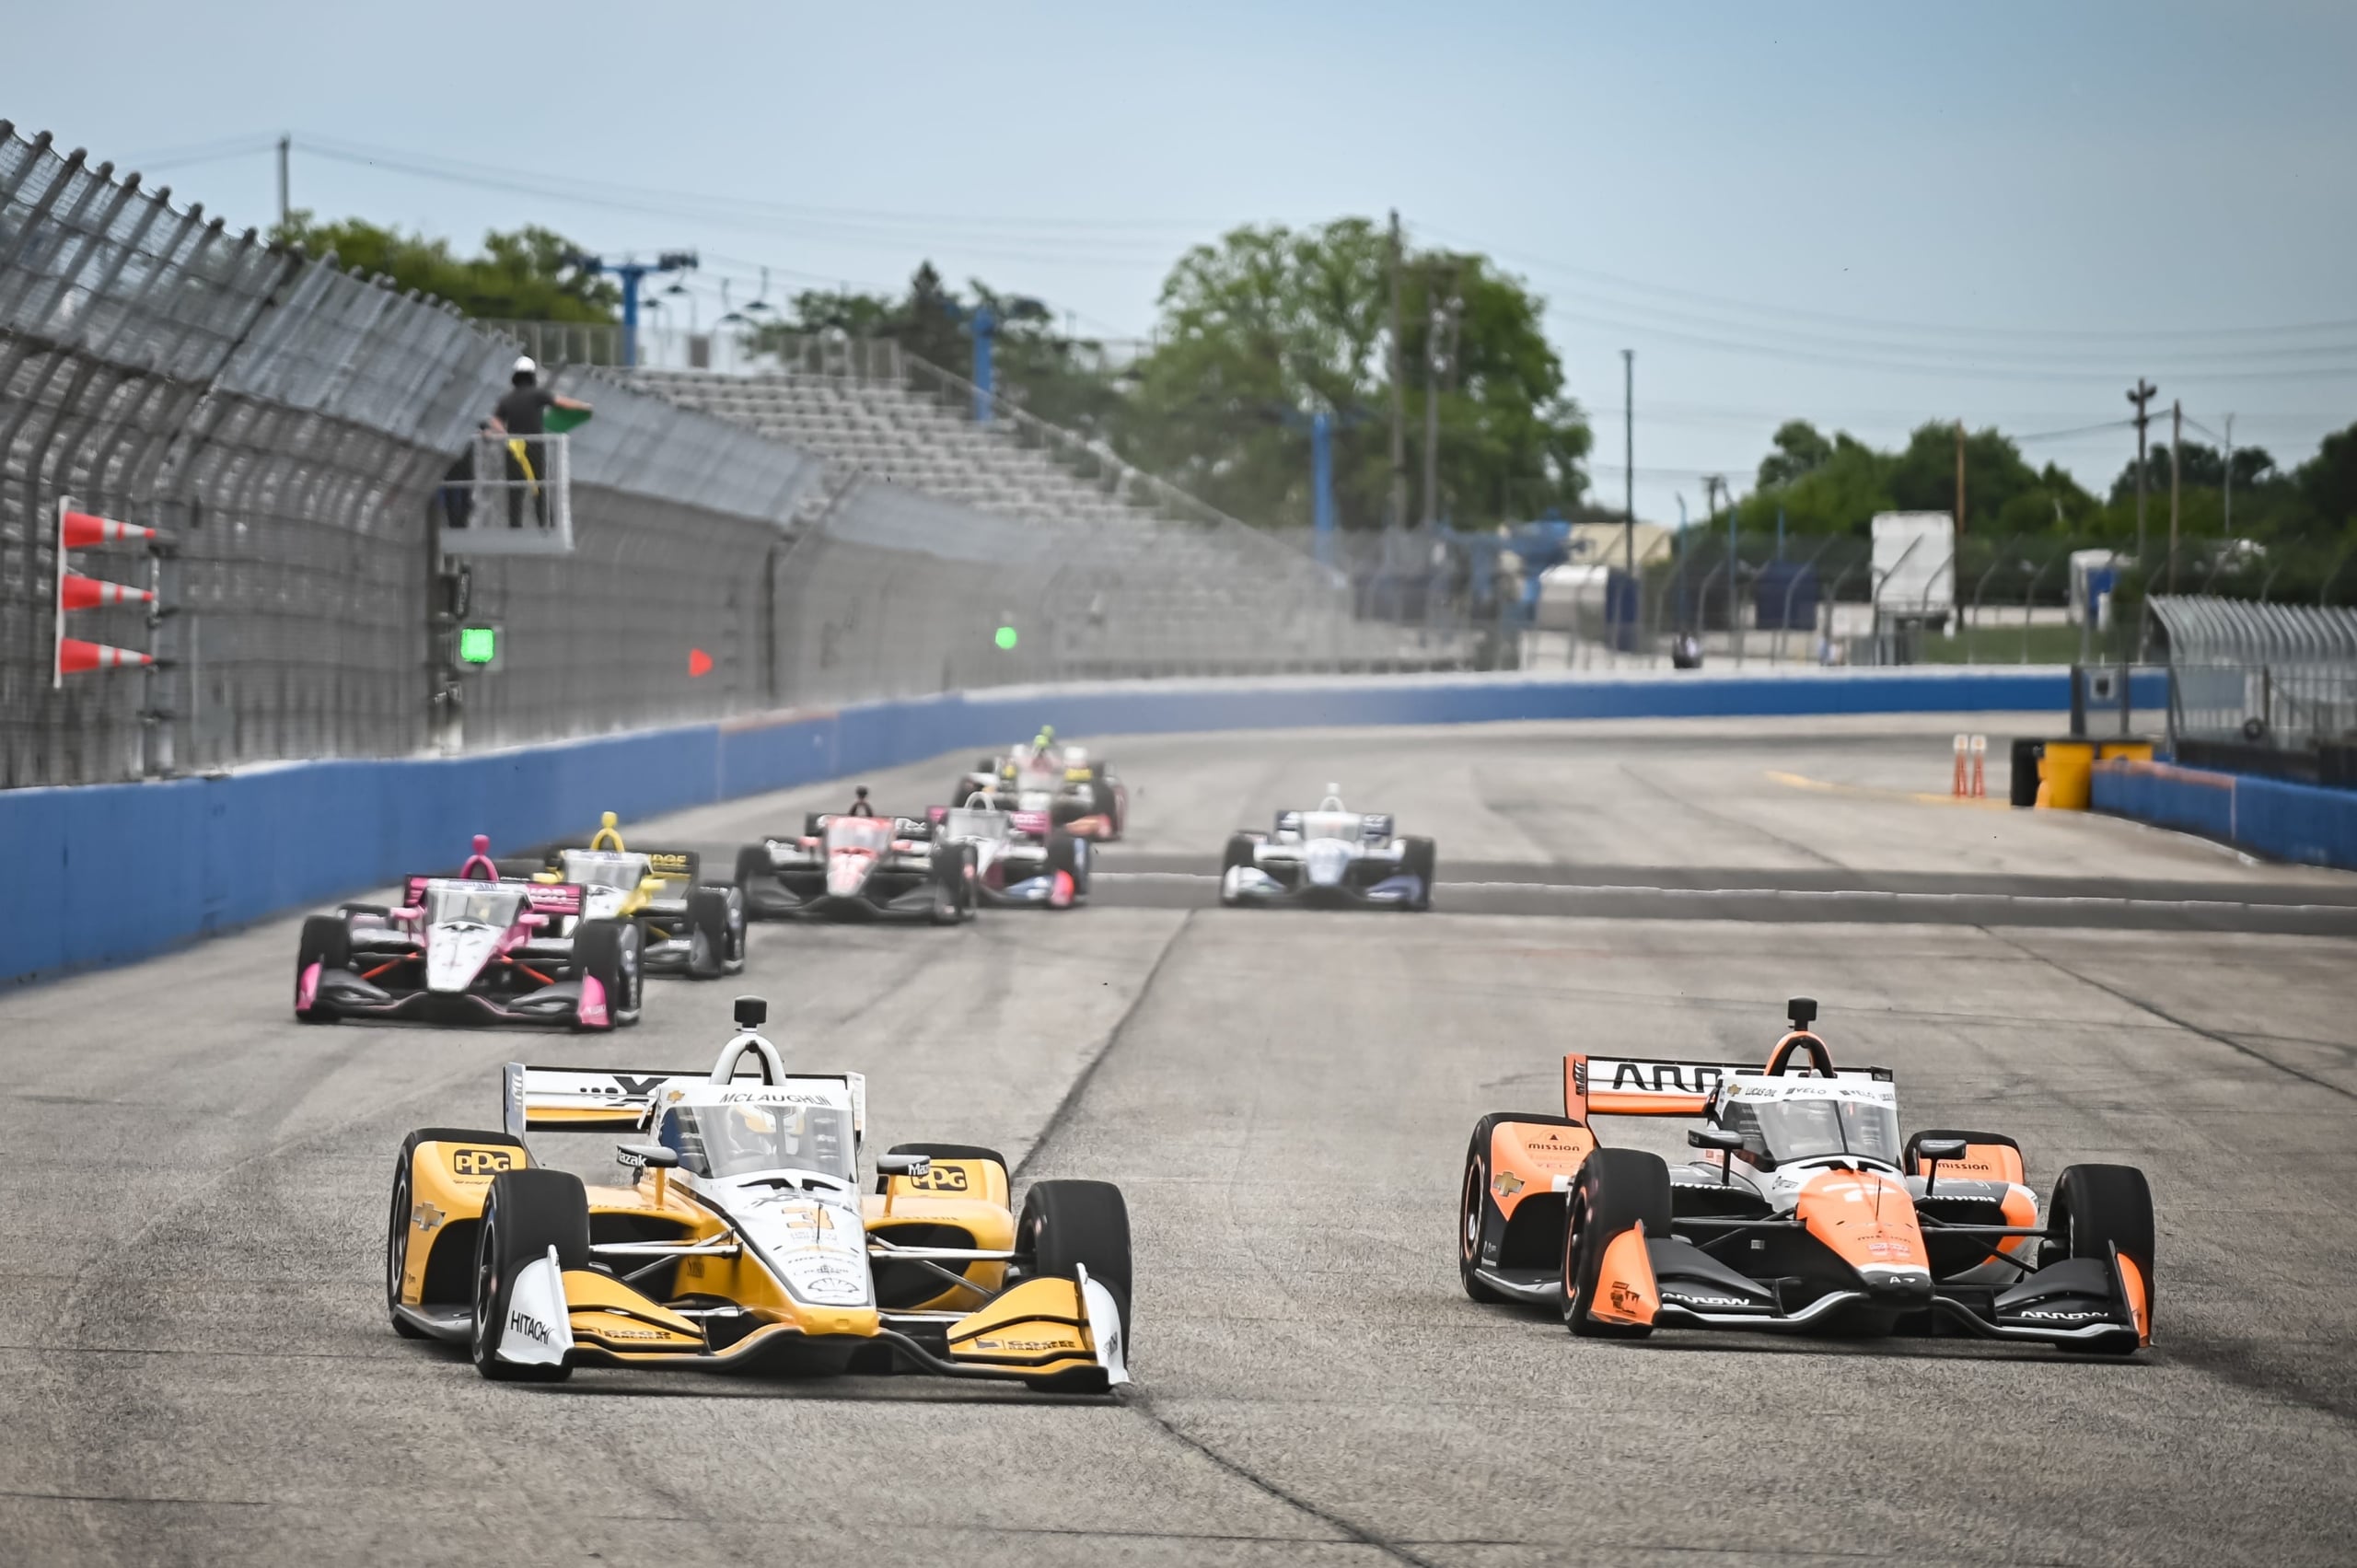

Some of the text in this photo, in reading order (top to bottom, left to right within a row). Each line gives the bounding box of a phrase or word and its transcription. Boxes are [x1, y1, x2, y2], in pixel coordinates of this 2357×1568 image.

[719, 1092, 832, 1107] MCLAUGHLIN
[1527, 1142, 1580, 1152] mission
[456, 1151, 509, 1175] PPG
[618, 1151, 646, 1167] azak
[908, 1162, 930, 1176] Maz
[1937, 1162, 1990, 1171] mission
[781, 1207, 834, 1230] 3
[2020, 1310, 2108, 1319] ARROW
